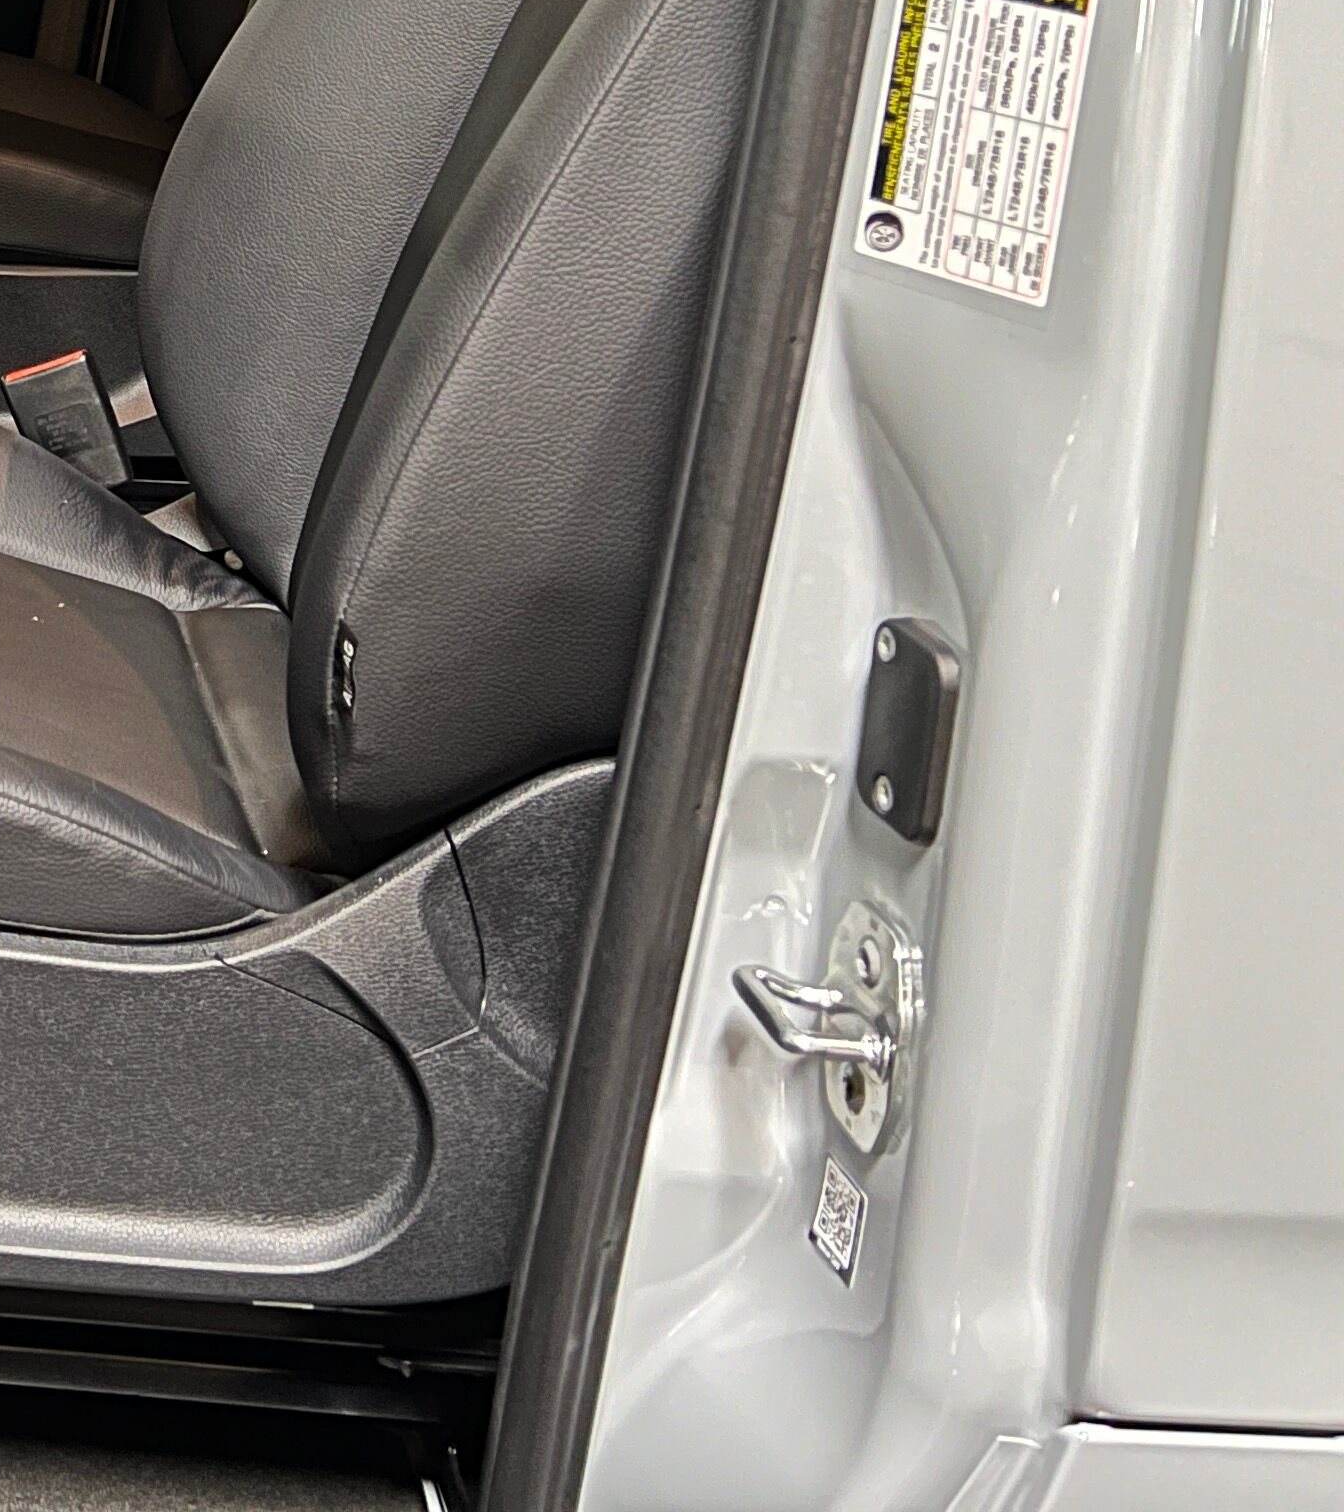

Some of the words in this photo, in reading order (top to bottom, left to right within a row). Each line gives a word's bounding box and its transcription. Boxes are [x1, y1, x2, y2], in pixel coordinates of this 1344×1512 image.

[891, 30, 911, 82] LOADING
[927, 41, 940, 53] 2
[922, 60, 936, 92] TOTAL
[886, 87, 901, 114] AND
[881, 119, 895, 146] TIRE
[342, 639, 355, 707] AIAG
